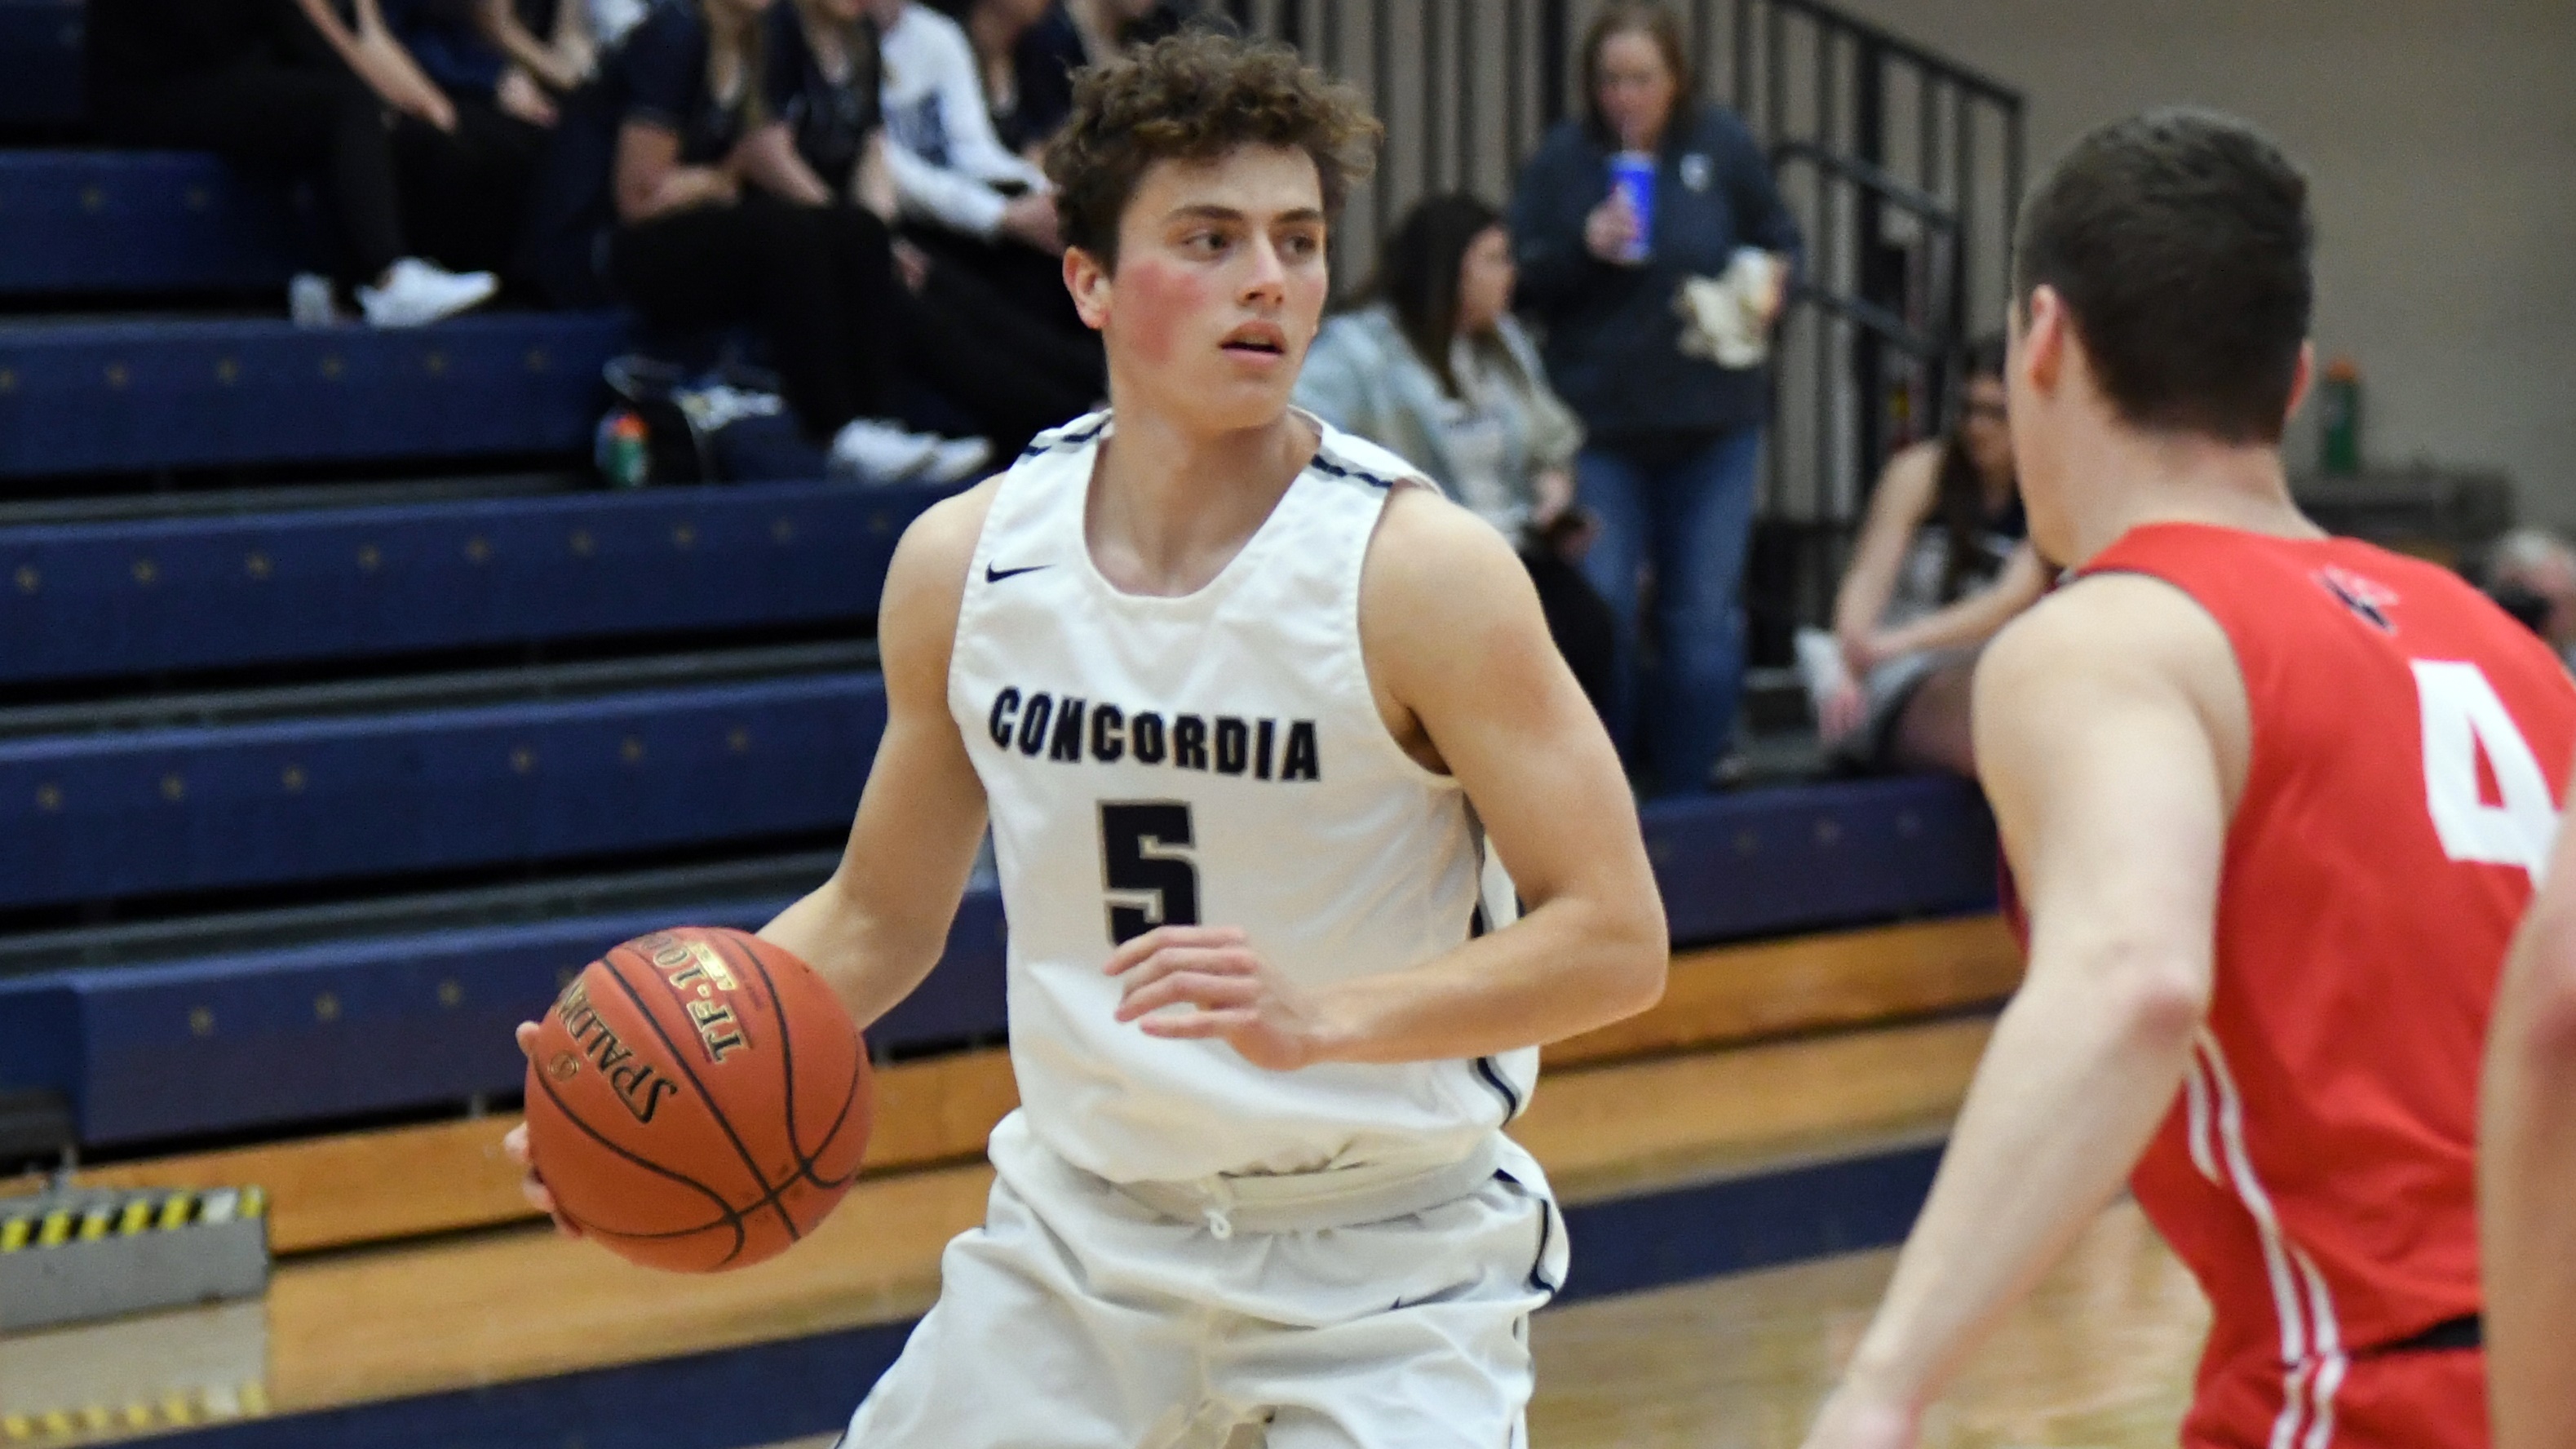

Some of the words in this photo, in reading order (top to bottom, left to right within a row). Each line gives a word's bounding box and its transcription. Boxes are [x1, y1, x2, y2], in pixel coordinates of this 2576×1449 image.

[988, 685, 1321, 782] CONCORDIA
[2409, 658, 2561, 891] 4
[1095, 798, 1201, 947] 5
